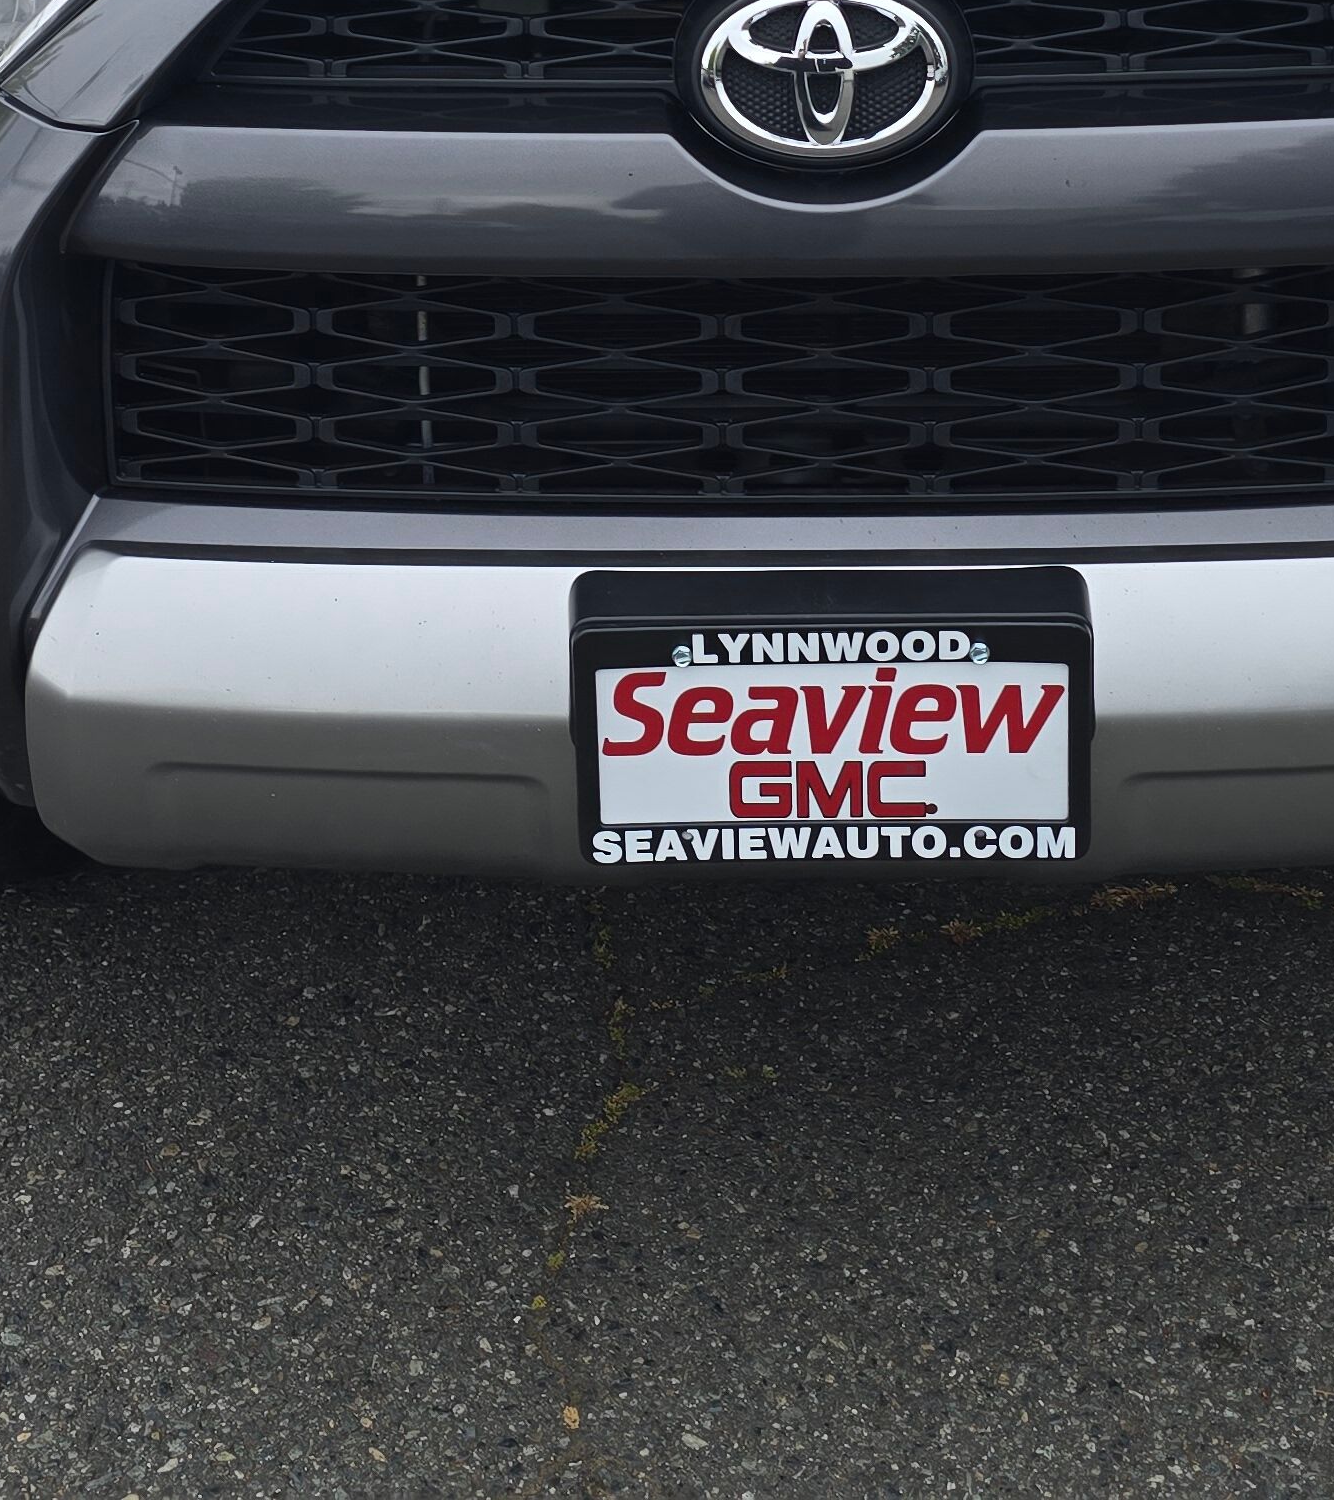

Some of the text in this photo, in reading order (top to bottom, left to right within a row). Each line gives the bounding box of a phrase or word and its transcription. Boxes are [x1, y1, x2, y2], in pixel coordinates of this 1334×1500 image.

[691, 630, 970, 664] LYNNWOOD
[601, 666, 1066, 757] Seaview
[728, 760, 928, 819] GMC
[592, 825, 1077, 864] SEAVIEWAUTO.COM
